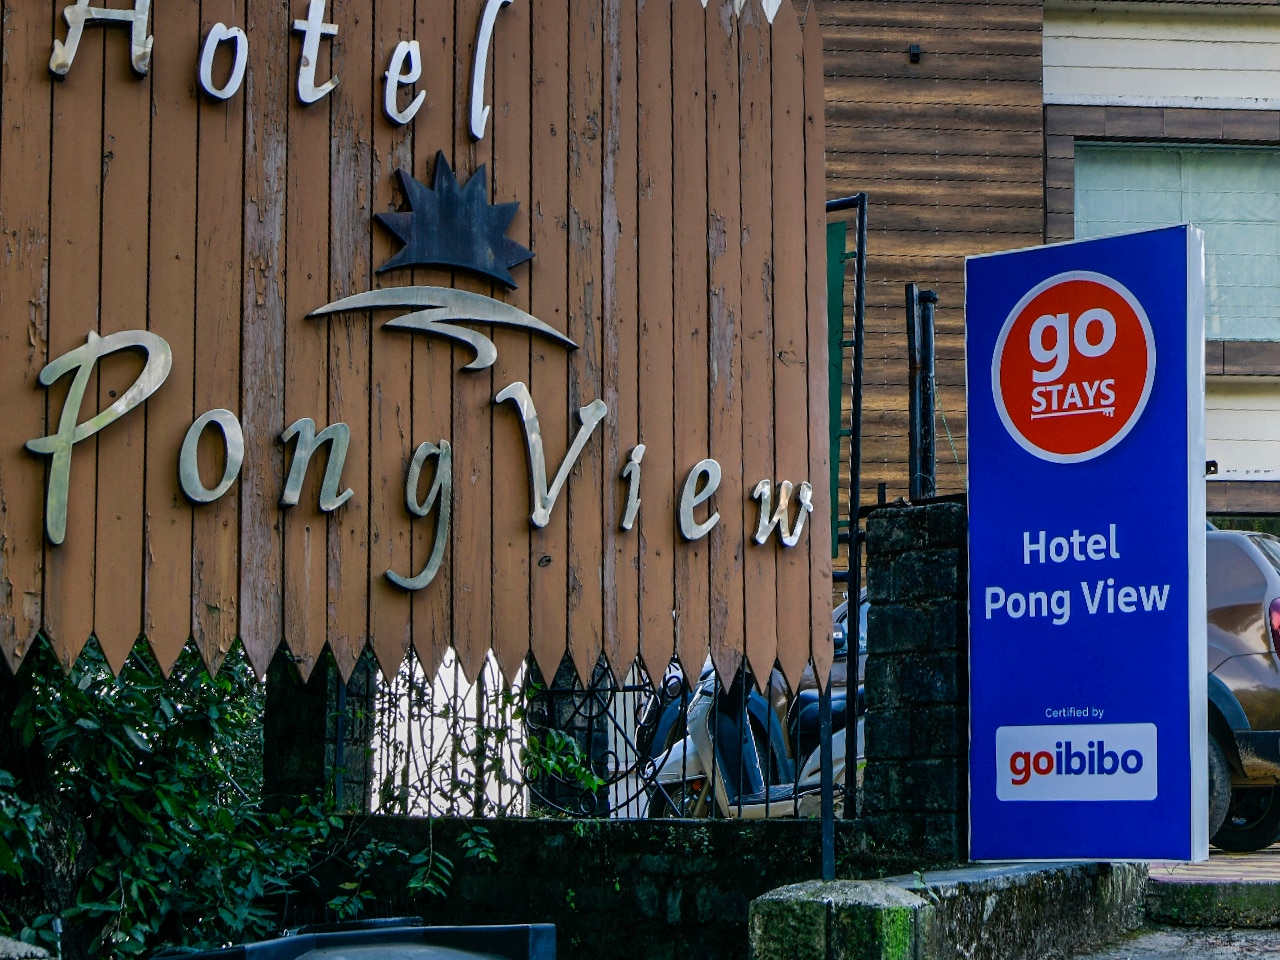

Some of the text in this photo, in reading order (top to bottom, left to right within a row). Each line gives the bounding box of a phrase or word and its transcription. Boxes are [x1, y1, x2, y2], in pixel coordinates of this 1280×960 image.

[1029, 307, 1117, 383] go
[1031, 378, 1115, 413] STAYS
[25, 329, 814, 590] Pong View
[1023, 523, 1120, 565] Hotel
[985, 578, 1171, 626] Pong View
[1045, 706, 1104, 719] Certified by
[1010, 741, 1143, 786] goibibo
